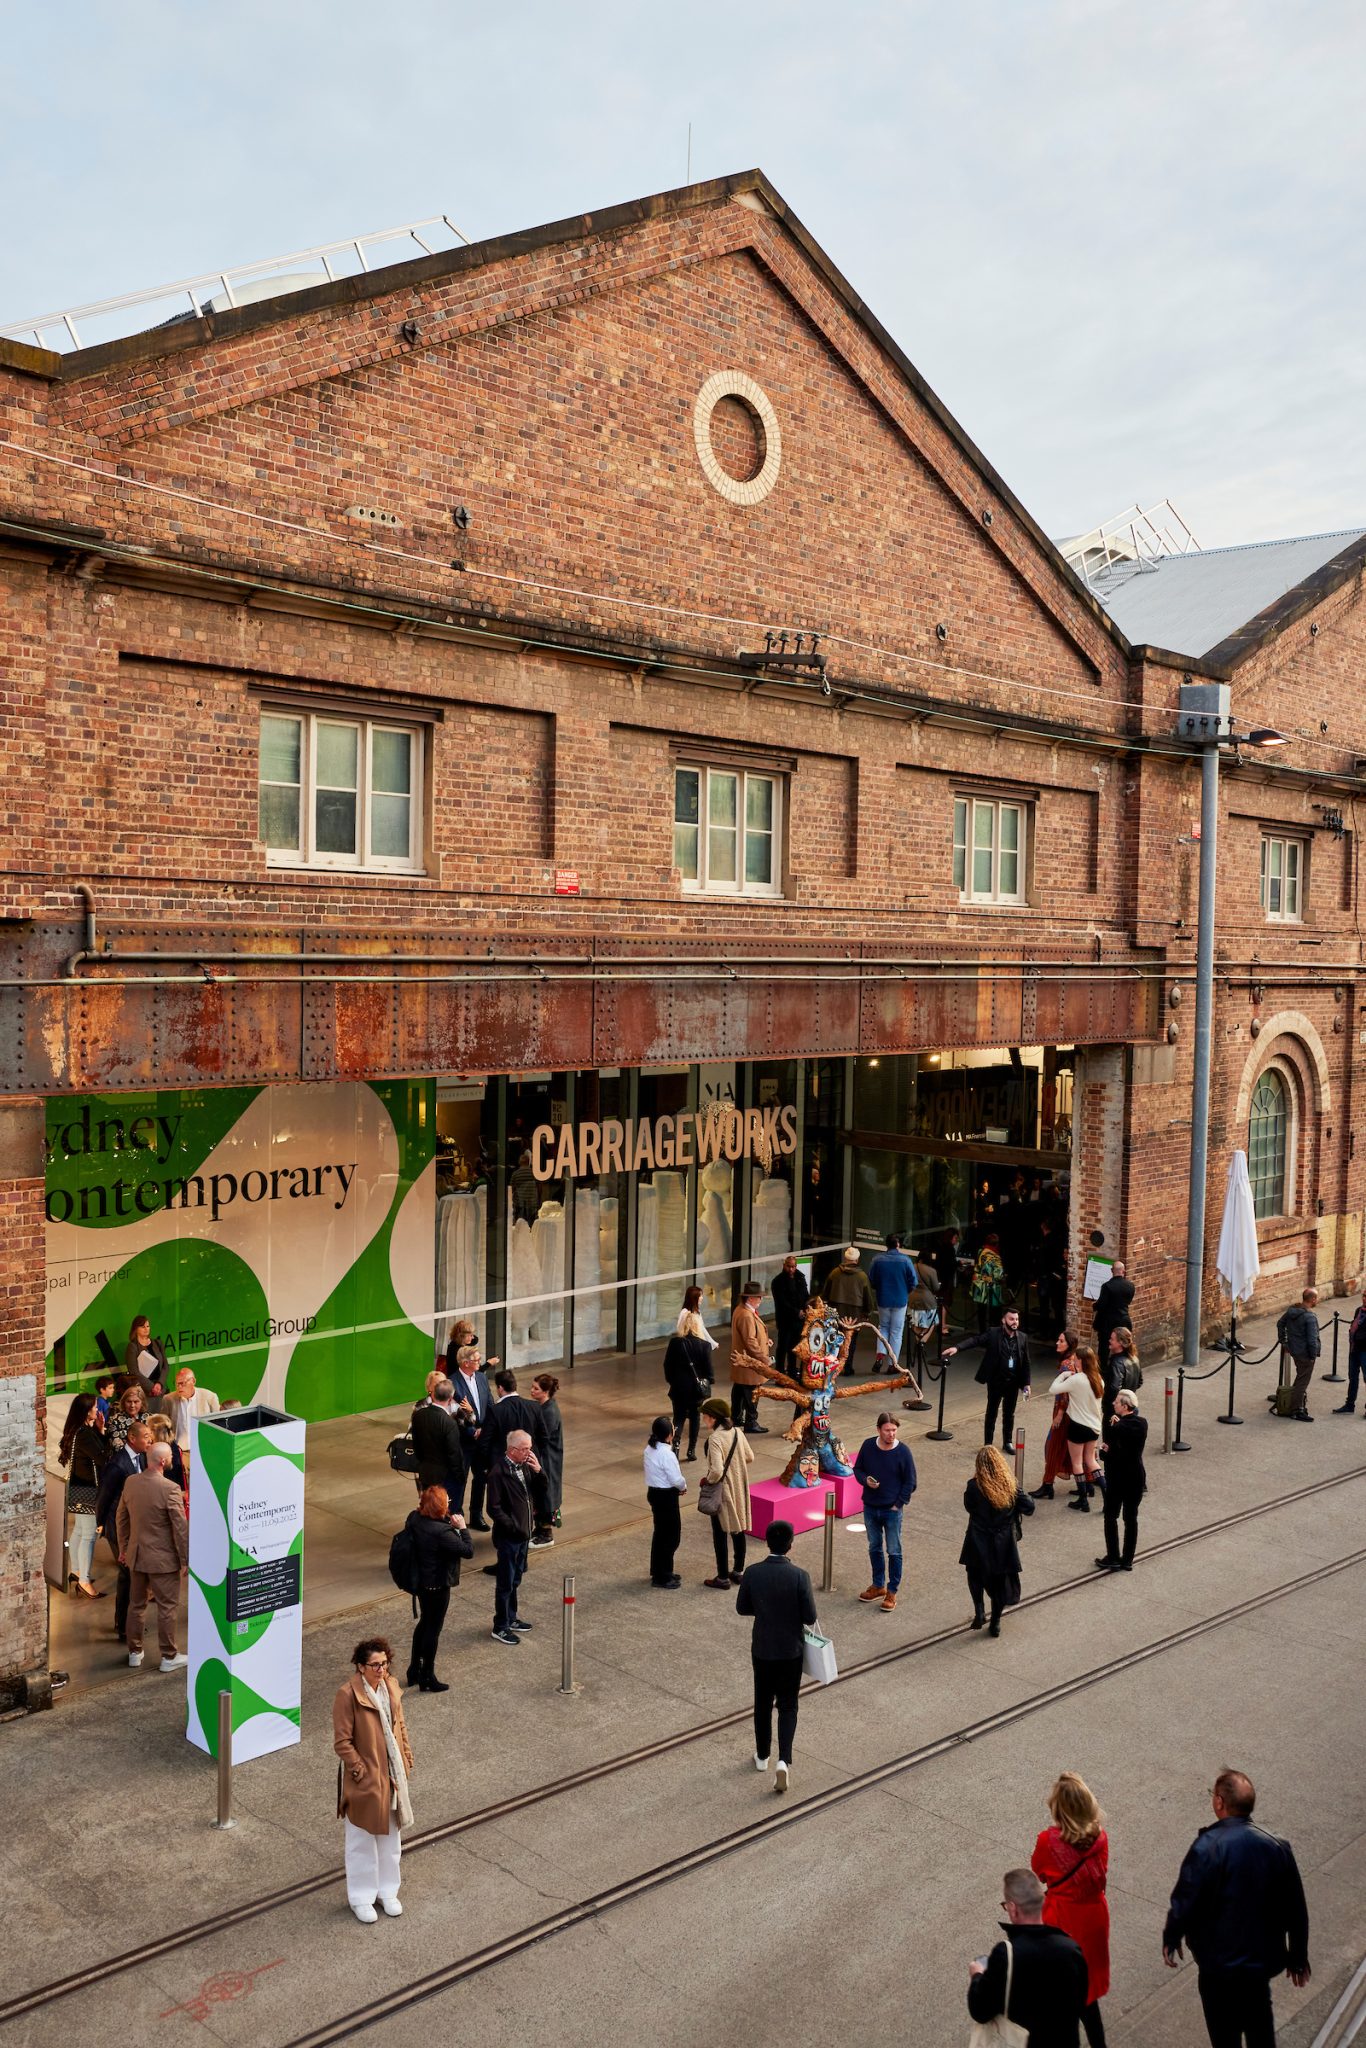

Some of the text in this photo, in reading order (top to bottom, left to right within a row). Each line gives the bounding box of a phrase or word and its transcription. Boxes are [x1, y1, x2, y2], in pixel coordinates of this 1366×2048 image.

[45, 1105, 184, 1165] ydney
[532, 1104, 798, 1182] CARRIAGEWORKS
[45, 1163, 359, 1223] ontemporary
[45, 1268, 132, 1293] ipal Partner
[178, 1320, 259, 1350] Financial
[263, 1316, 317, 1338] Group
[238, 1503, 297, 1522] Contemporary
[239, 1500, 268, 1514] Sydney
[238, 1523, 249, 1534] 08
